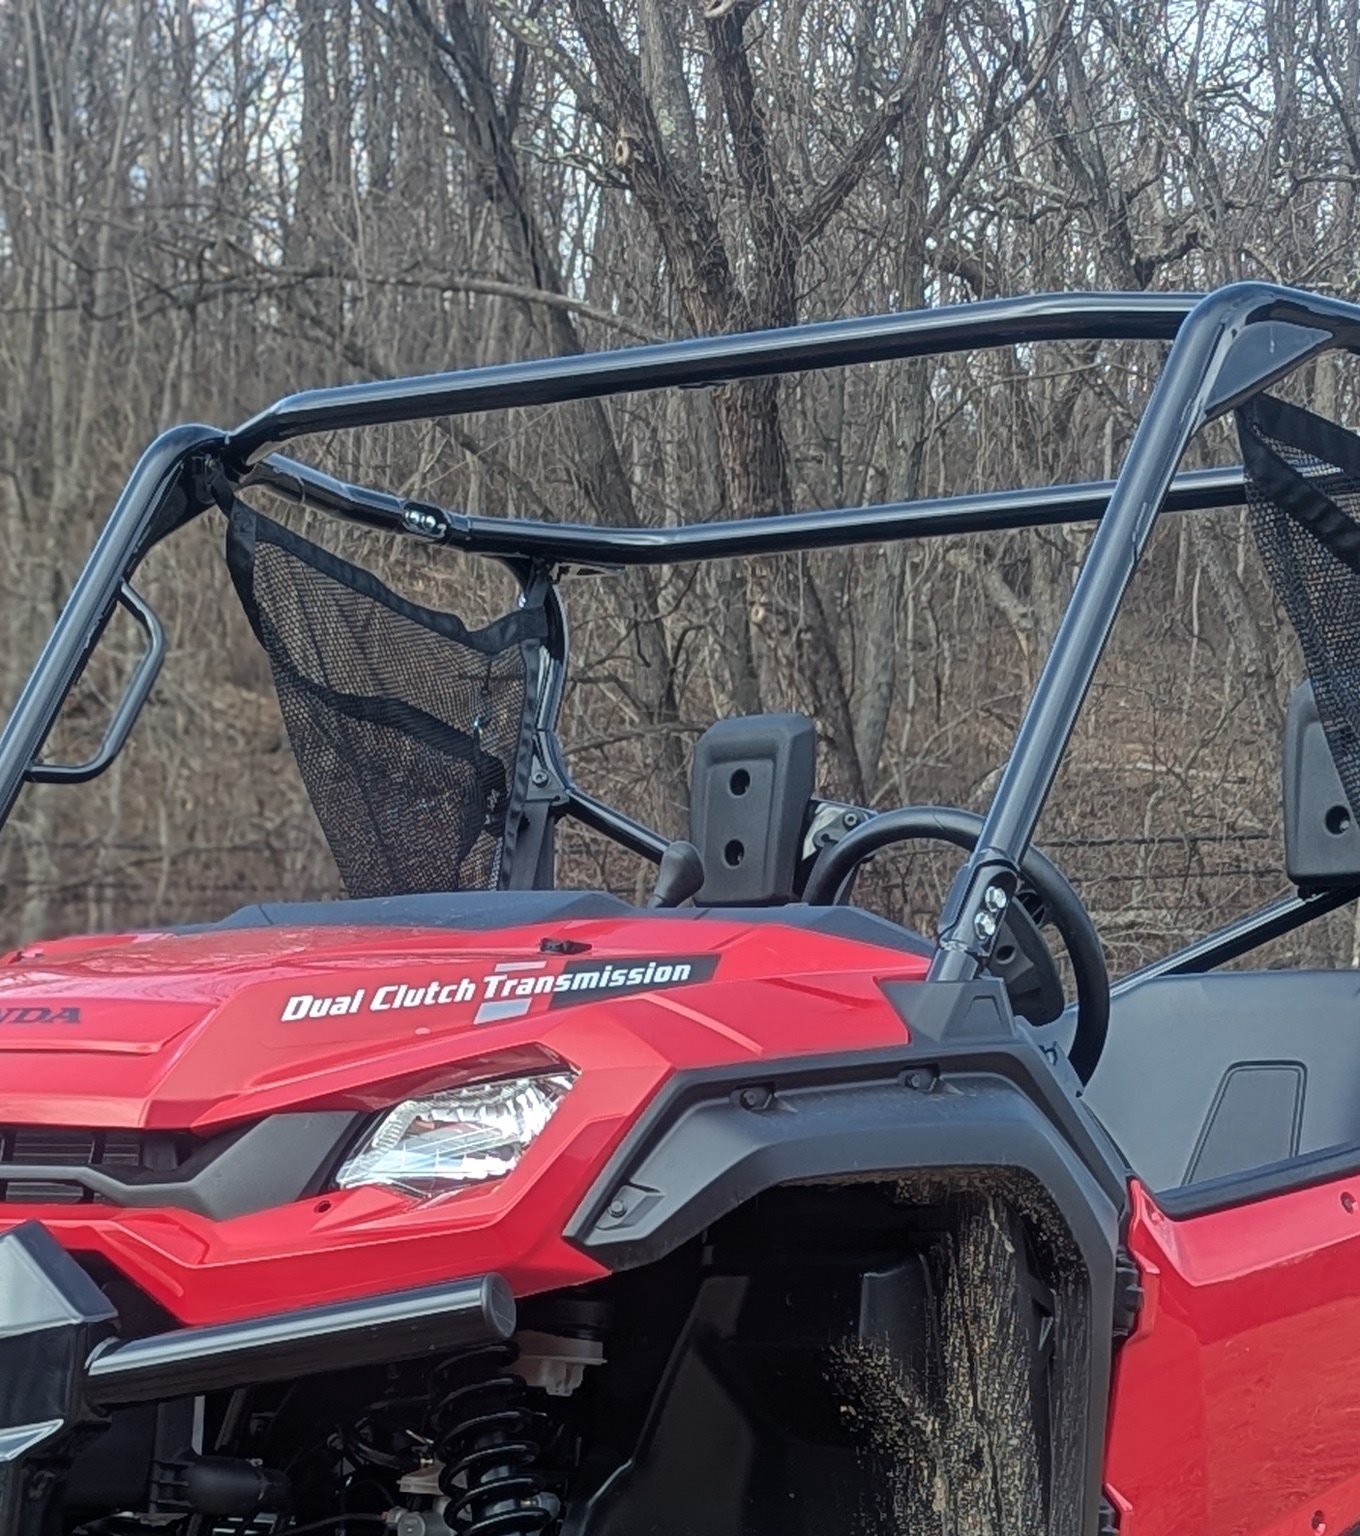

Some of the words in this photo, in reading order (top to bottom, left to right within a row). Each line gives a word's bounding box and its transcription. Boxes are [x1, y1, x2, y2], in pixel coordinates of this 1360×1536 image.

[281, 989, 365, 1021] Dual
[370, 978, 476, 1011] Clutch
[484, 962, 691, 999] Transmission
